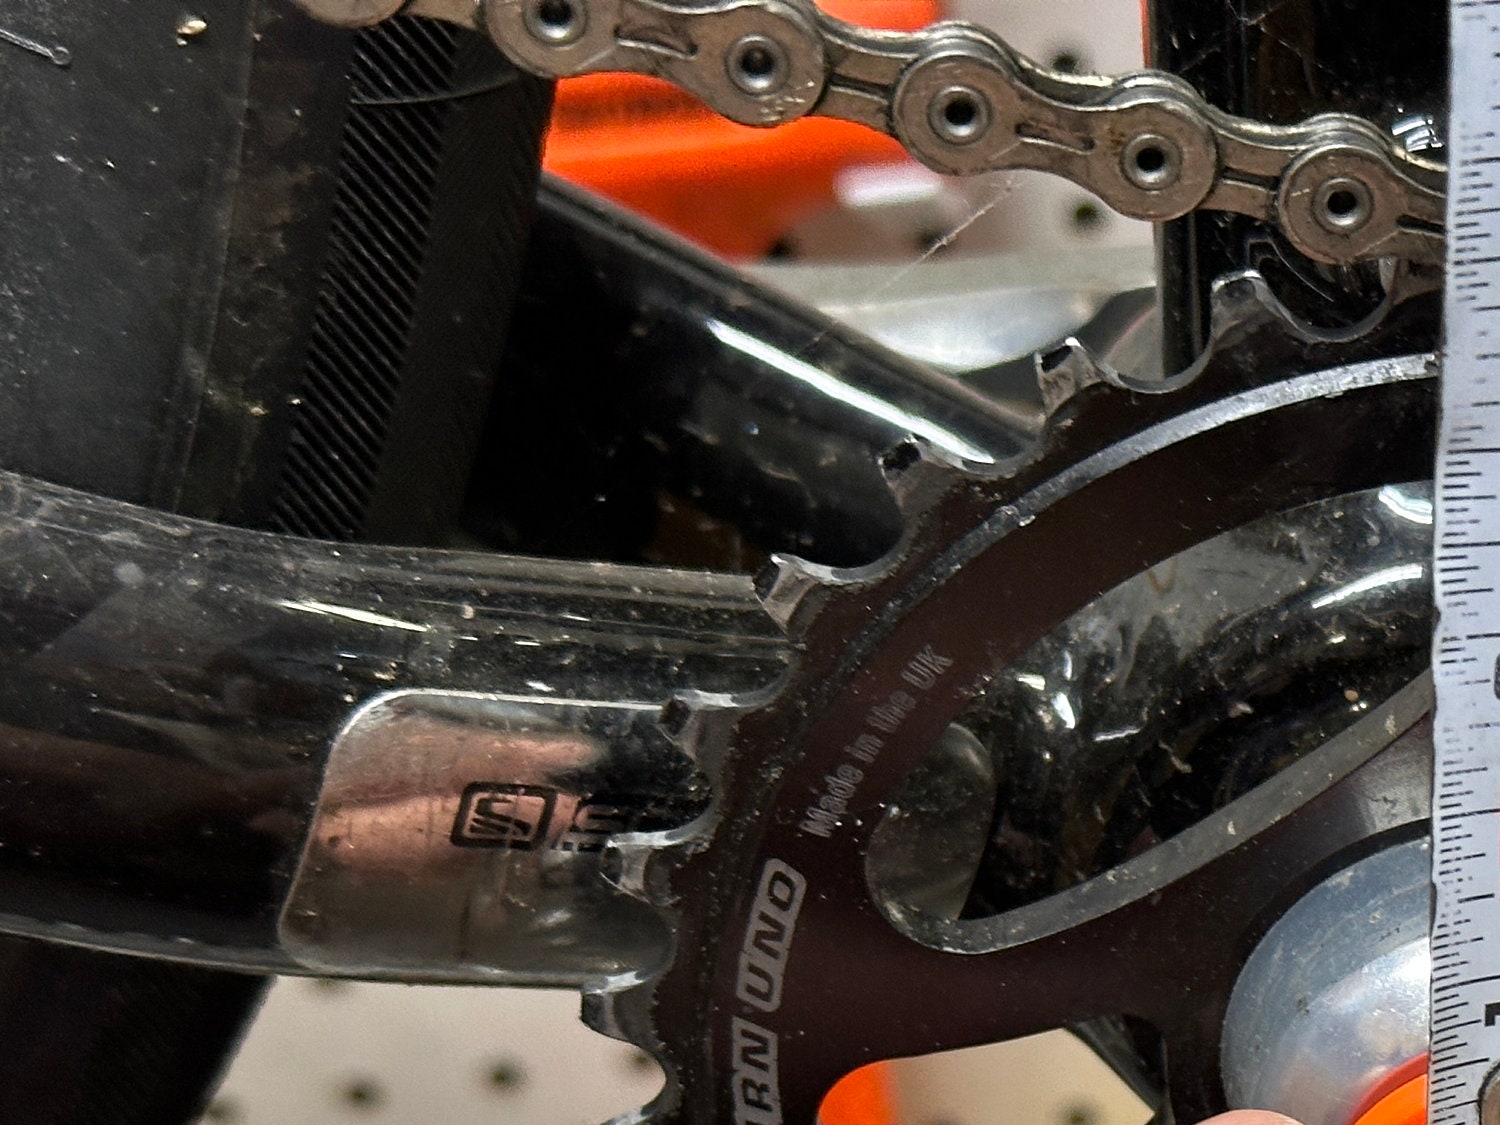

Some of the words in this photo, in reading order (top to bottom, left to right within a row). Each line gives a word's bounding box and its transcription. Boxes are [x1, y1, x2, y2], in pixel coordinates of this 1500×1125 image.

[800, 764, 864, 839] Made
[843, 733, 885, 764] in
[865, 690, 917, 734] the
[901, 644, 954, 690] UK
[743, 868, 799, 1004] UNO
